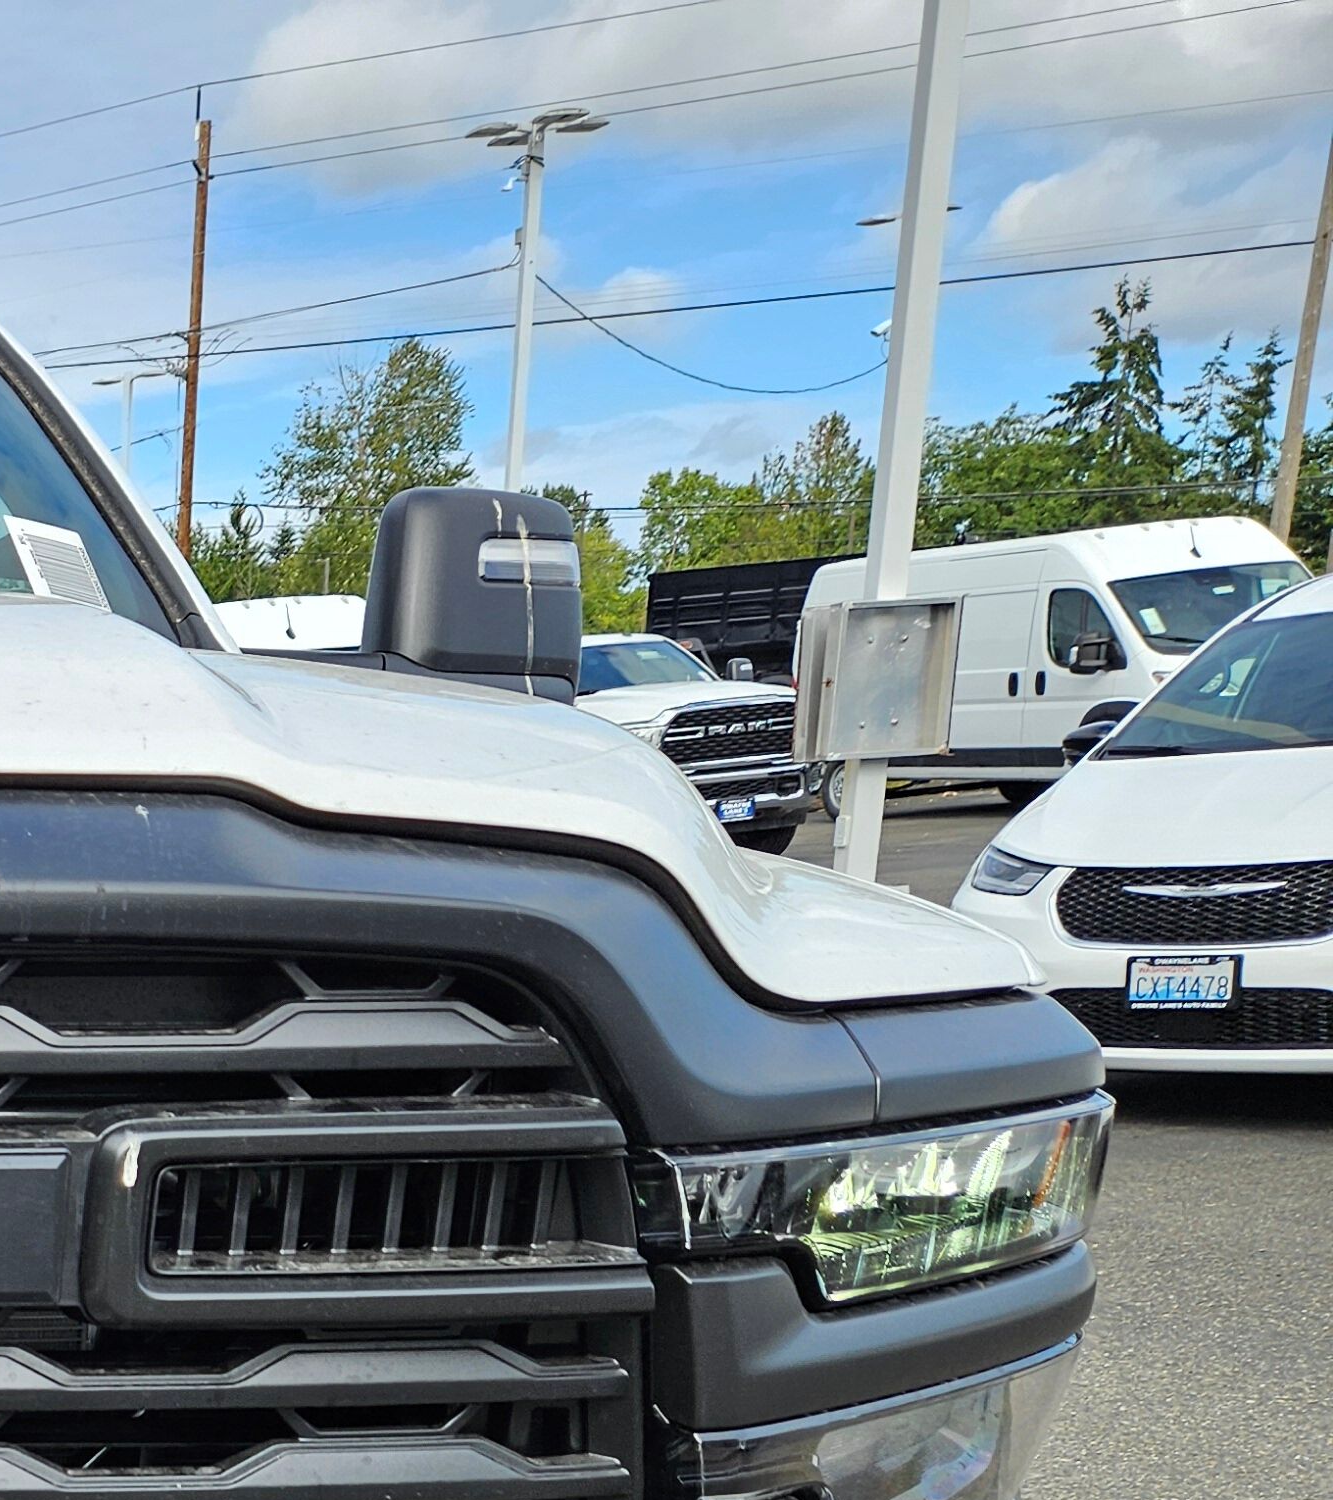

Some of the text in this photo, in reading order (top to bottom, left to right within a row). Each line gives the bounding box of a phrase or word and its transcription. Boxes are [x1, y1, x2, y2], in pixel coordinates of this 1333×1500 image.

[708, 720, 773, 736] RAM
[1139, 965, 1194, 973] WASHINGTON
[1136, 976, 1229, 999] CXT4478
